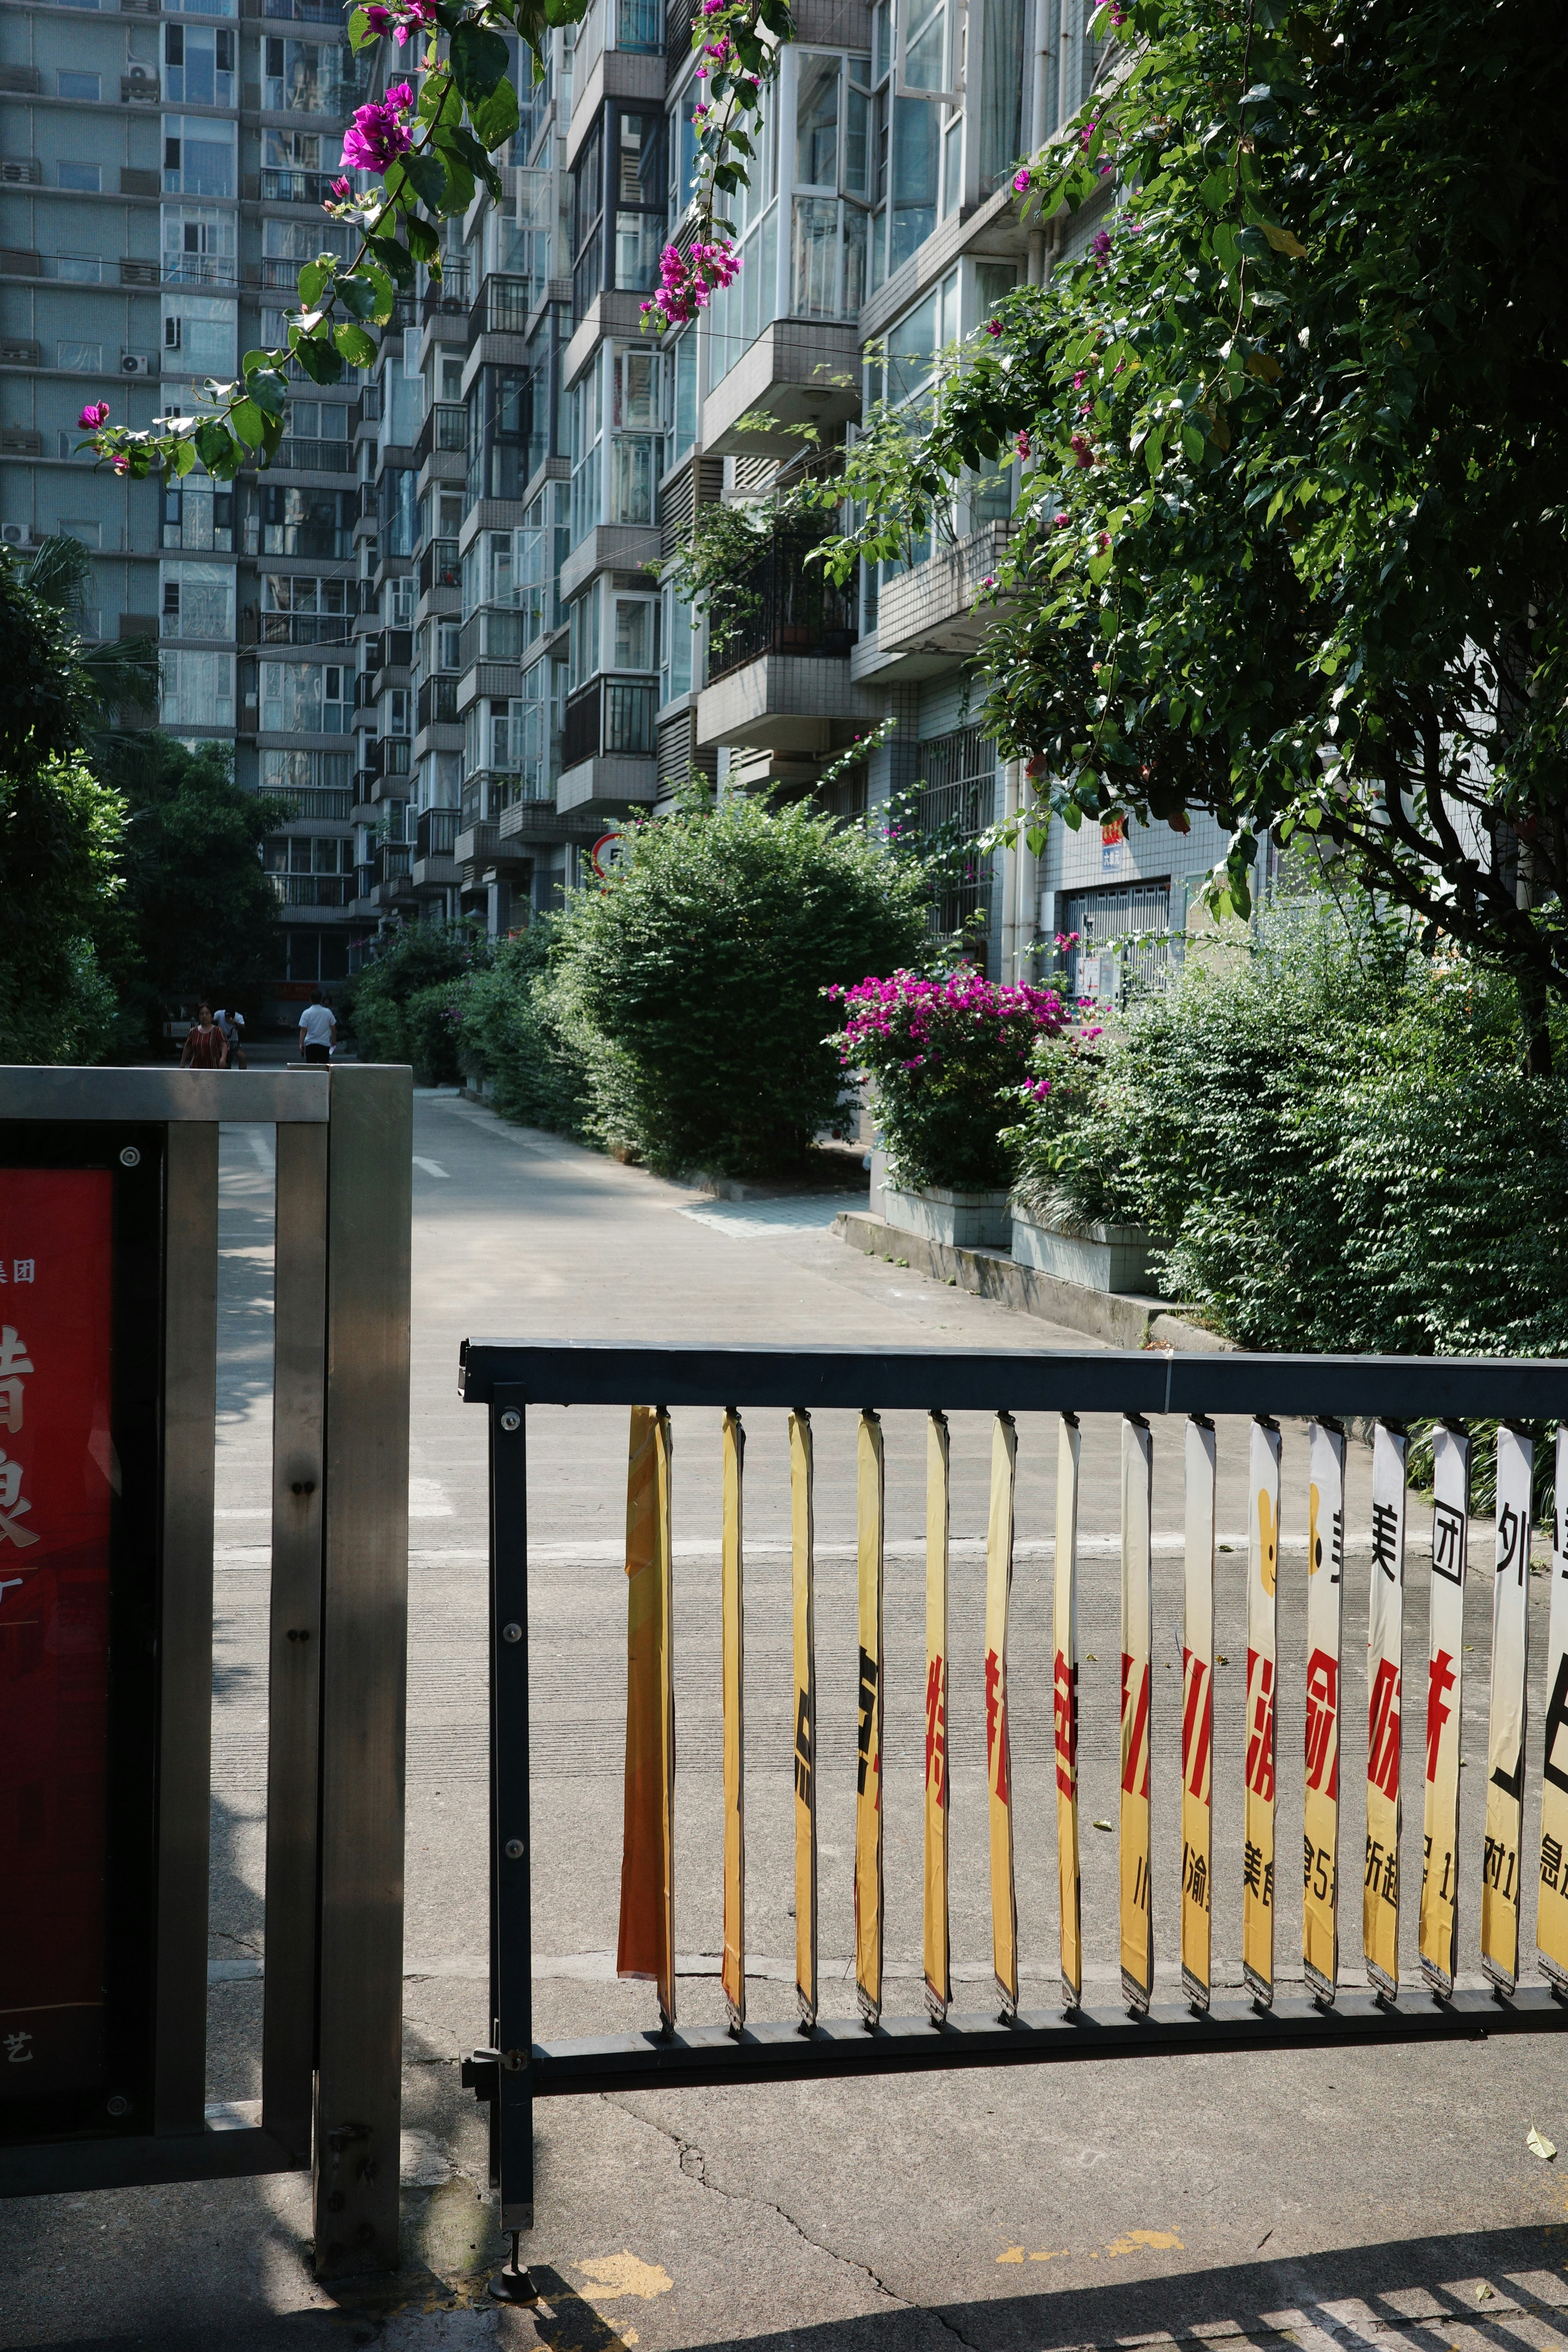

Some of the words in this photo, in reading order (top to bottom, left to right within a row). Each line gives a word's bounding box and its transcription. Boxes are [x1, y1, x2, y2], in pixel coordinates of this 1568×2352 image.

[1103, 850, 1120, 866] 六单元
[1371, 1498, 1568, 1587] 美团外
[3, 2032, 33, 2062] 艺
